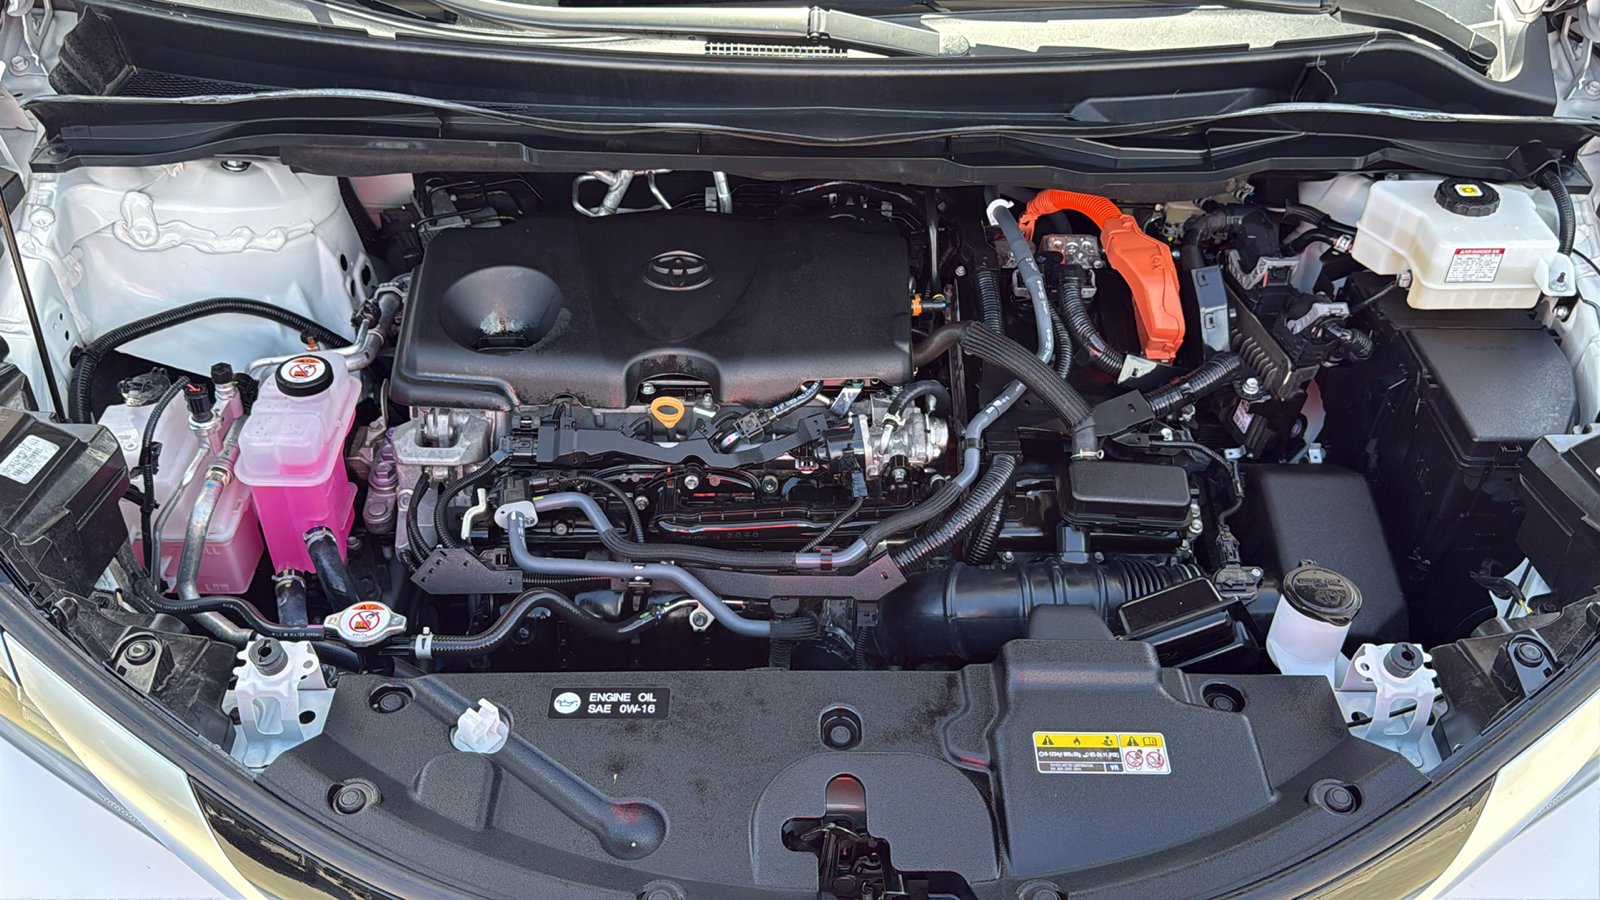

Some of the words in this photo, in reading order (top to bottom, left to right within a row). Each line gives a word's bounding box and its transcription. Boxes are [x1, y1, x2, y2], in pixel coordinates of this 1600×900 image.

[589, 692, 631, 702] ENGINE
[637, 692, 657, 702] OIL
[587, 704, 612, 713] SAE
[619, 704, 656, 713] 0W-16
